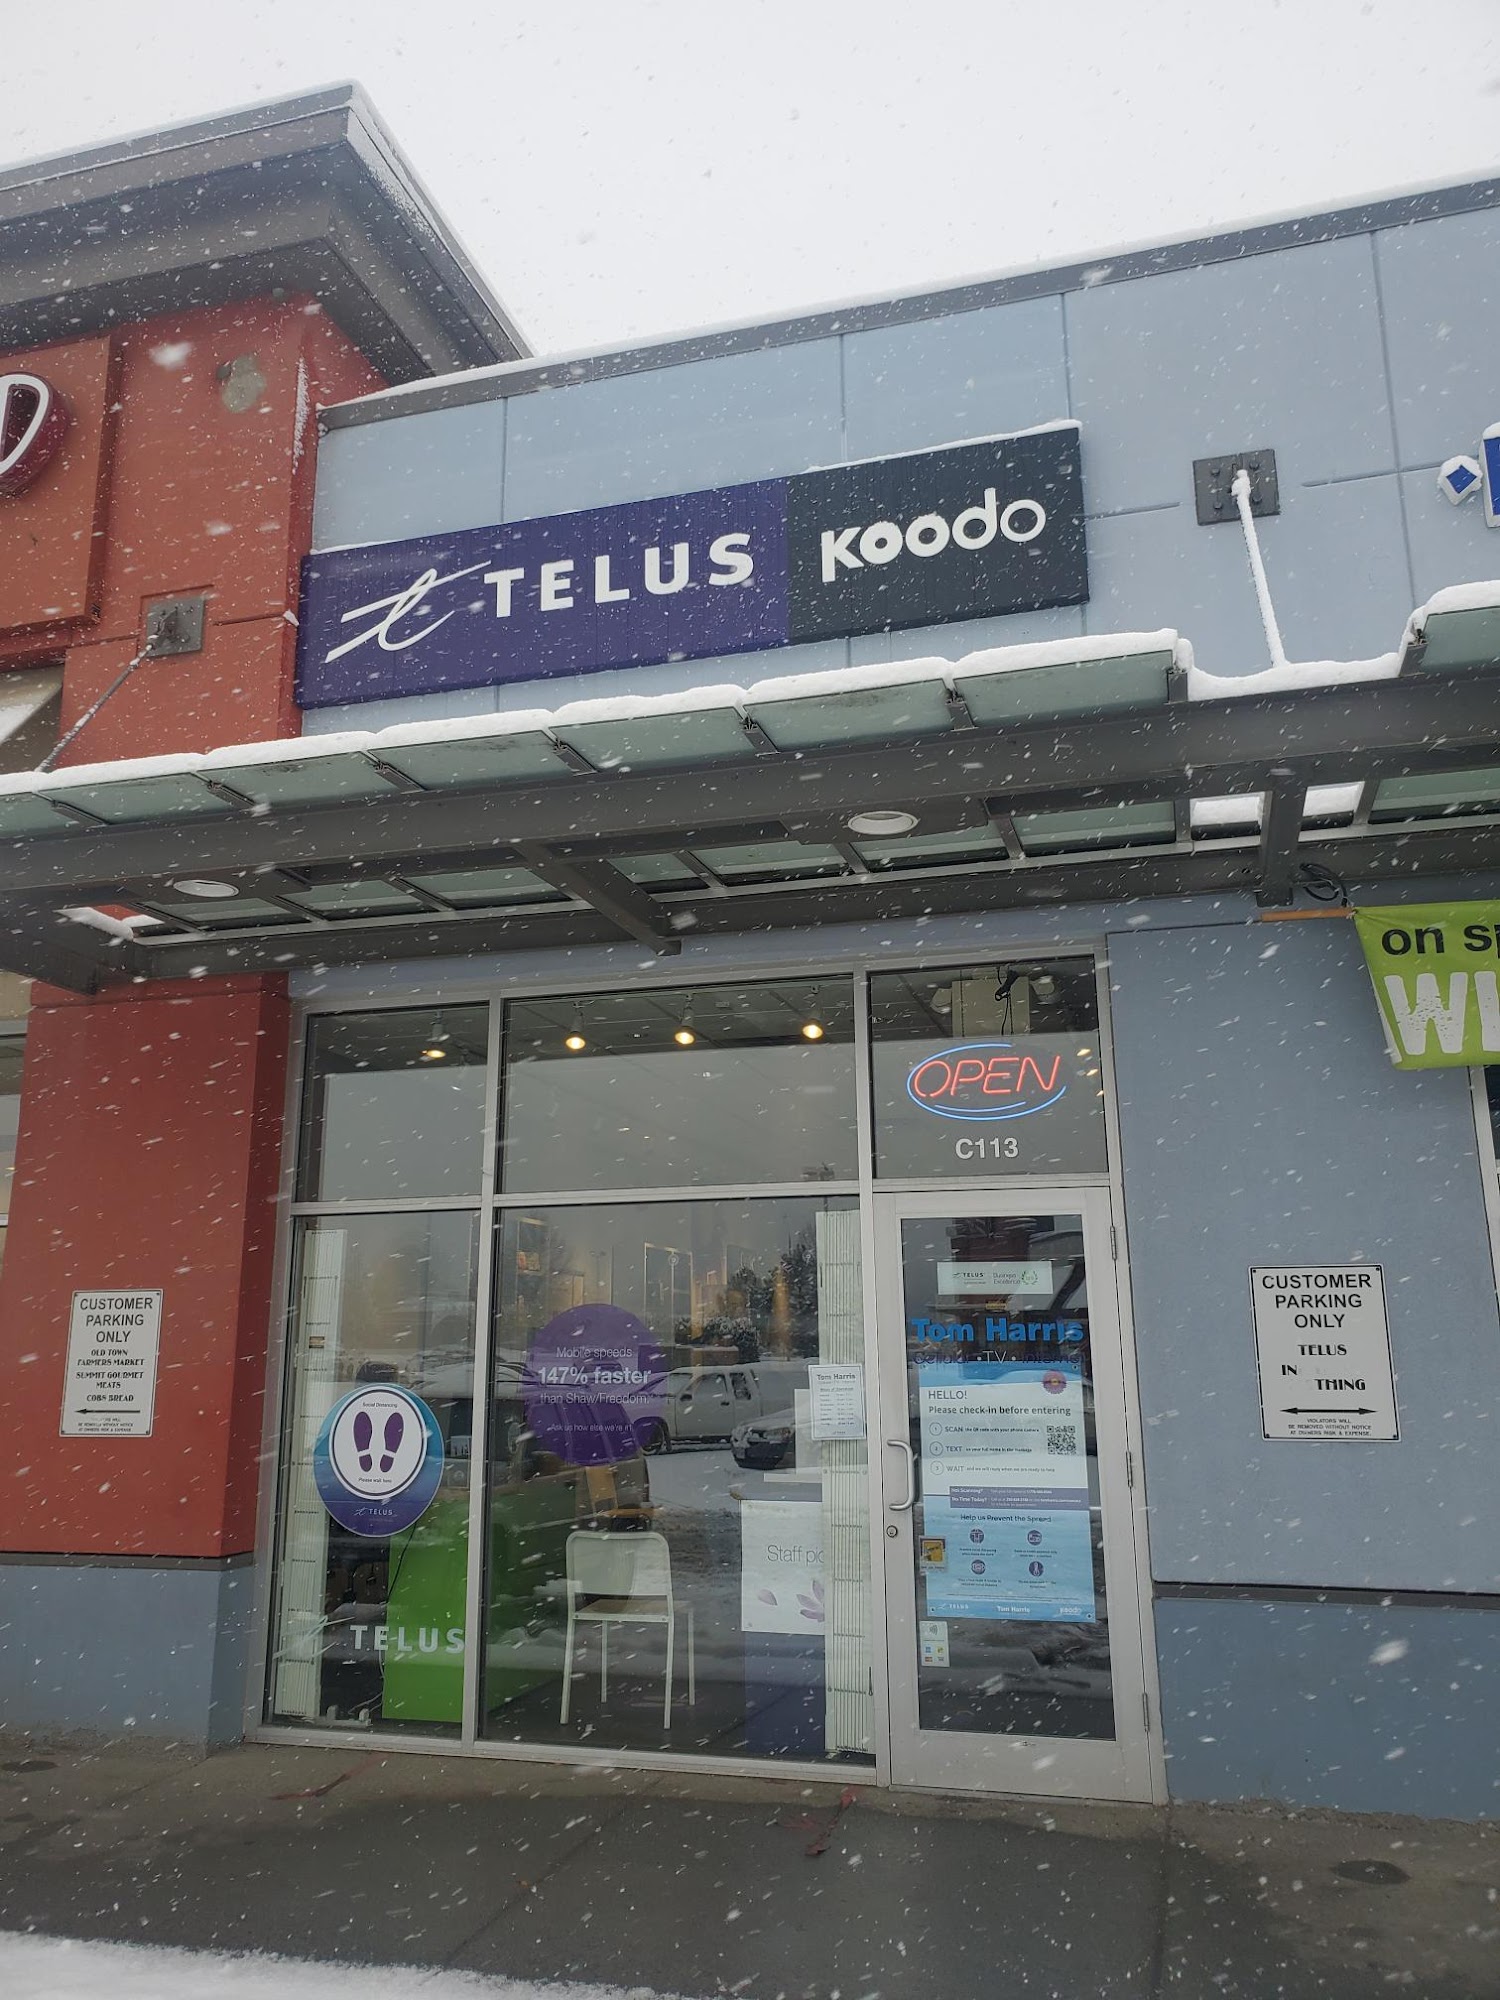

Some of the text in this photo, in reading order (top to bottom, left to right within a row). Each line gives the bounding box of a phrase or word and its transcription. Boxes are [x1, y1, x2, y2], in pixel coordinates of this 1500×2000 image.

[483, 532, 755, 618] TELUS
[1381, 926, 1445, 956] on
[913, 1055, 1061, 1098] OPEN
[955, 1137, 1019, 1160] C113
[1262, 1273, 1372, 1289] CUSTOMER
[80, 1297, 153, 1311] CUSTOMER
[1275, 1294, 1362, 1308] PARKING
[86, 1314, 144, 1327] PARKING
[1294, 1314, 1345, 1328] ONLY
[911, 1317, 1085, 1343] Tom Harris
[96, 1331, 131, 1343] ONLY
[91, 1349, 128, 1357] OLD TOWN
[556, 1346, 633, 1360] Mobile speeds
[1297, 1344, 1347, 1356] TELUS
[982, 1350, 1007, 1365] TV
[76, 1371, 144, 1379] SUMMIT GOURMET
[538, 1366, 651, 1385] 147% faster
[817, 1372, 856, 1381] Tom Harris
[1281, 1364, 1298, 1376] IN
[96, 1381, 121, 1389] MEATS
[1314, 1378, 1366, 1391] THING
[108, 1394, 134, 1402] BREAD
[540, 1393, 563, 1405] than
[928, 1390, 968, 1400] HELLO!
[928, 1406, 1071, 1416] Please check-in before entering
[368, 1508, 393, 1516] TELUS
[960, 1514, 977, 1522] Help
[767, 1544, 802, 1563] Staff
[1011, 1605, 1031, 1613] Harris
[350, 1625, 465, 1655] TELUS
